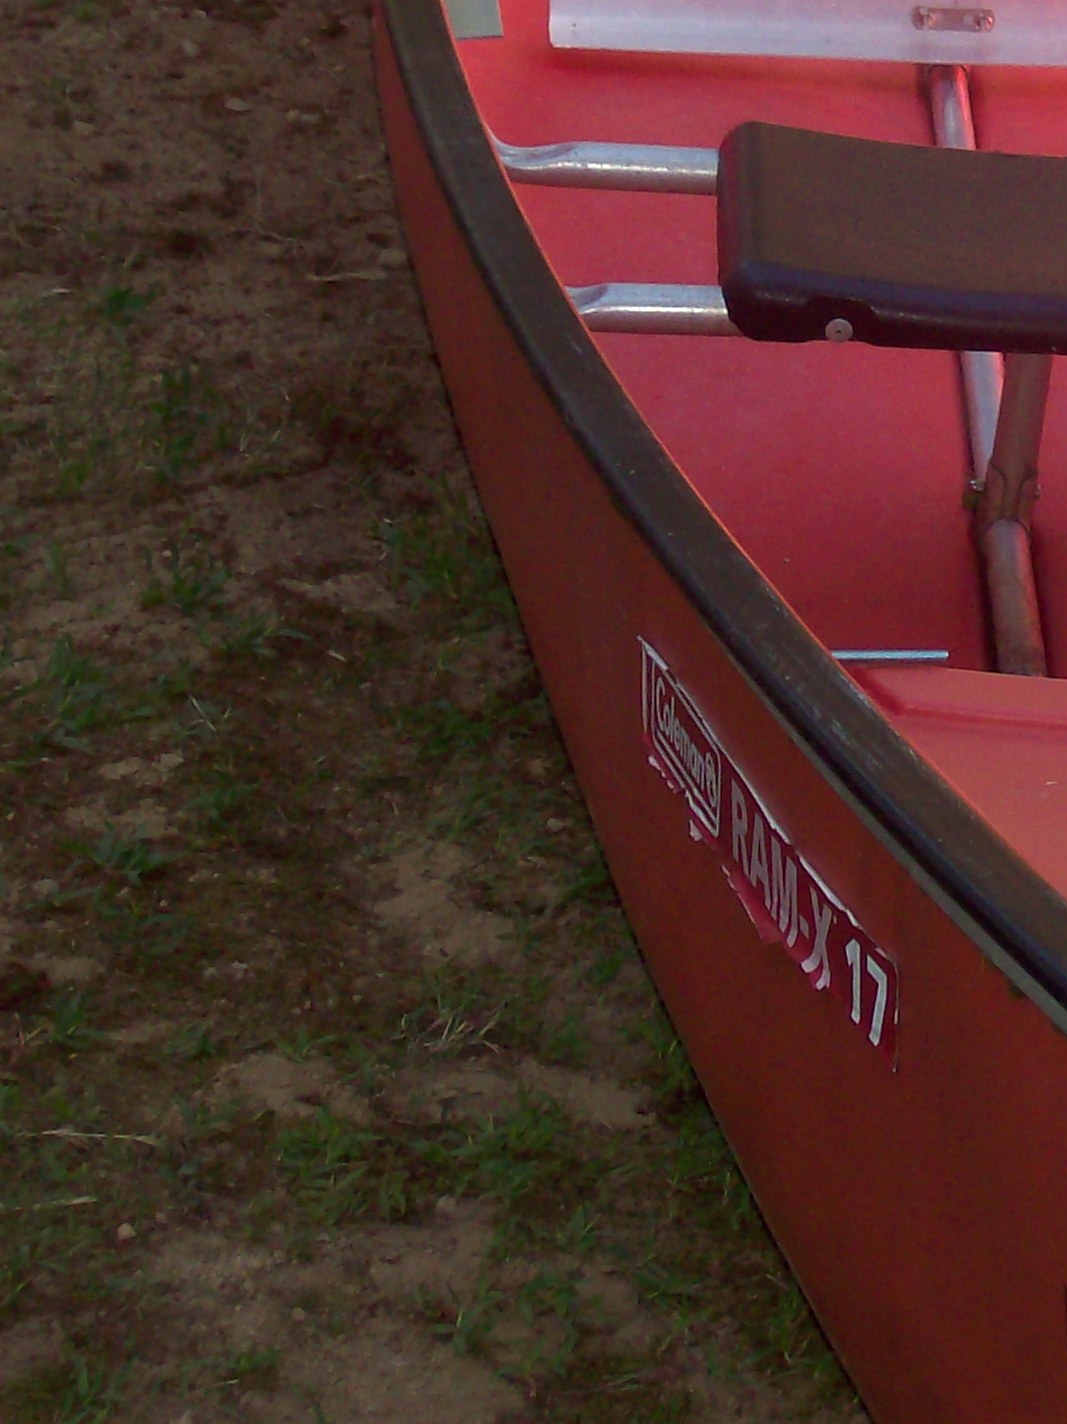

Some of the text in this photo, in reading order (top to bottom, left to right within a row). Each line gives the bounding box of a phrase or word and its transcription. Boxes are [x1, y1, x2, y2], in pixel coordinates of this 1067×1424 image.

[656, 676, 888, 1047] Coleman RAM-X 17
